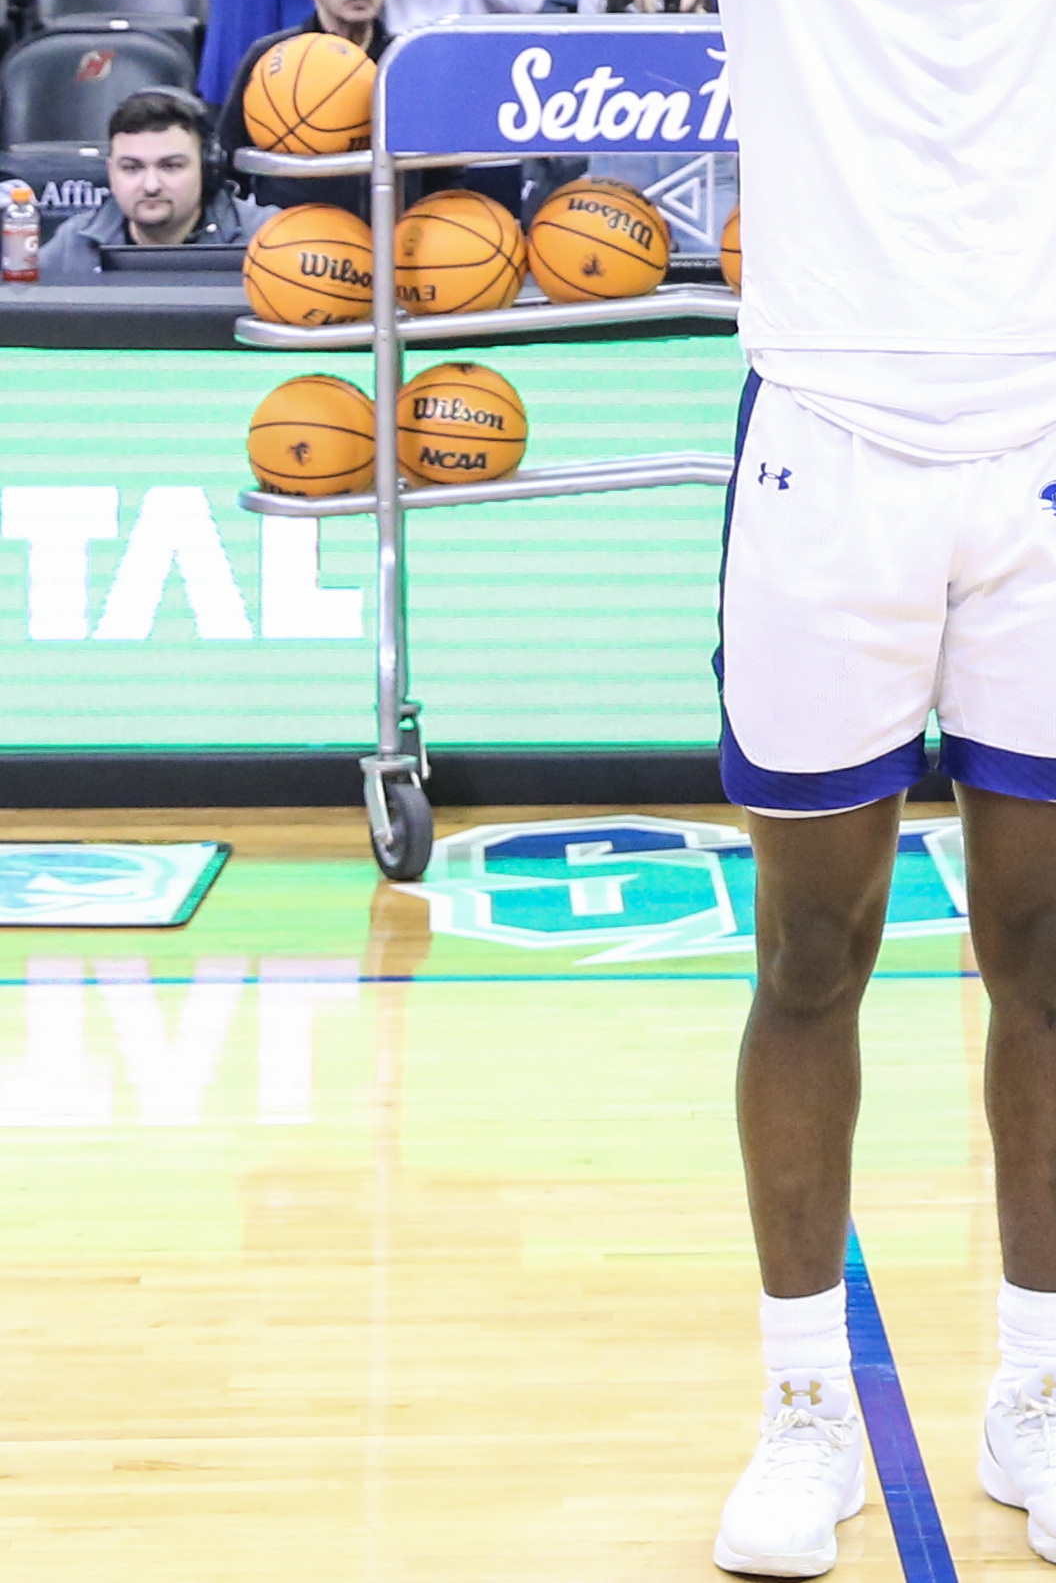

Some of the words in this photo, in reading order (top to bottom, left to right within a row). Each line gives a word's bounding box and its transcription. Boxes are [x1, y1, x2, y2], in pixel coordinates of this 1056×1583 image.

[498, 47, 692, 143] Seton
[568, 197, 653, 251] Wilson
[300, 251, 373, 288] Wilso
[413, 397, 505, 431] Wilson
[420, 447, 488, 470] NCAA
[1, 486, 364, 639] TAL
